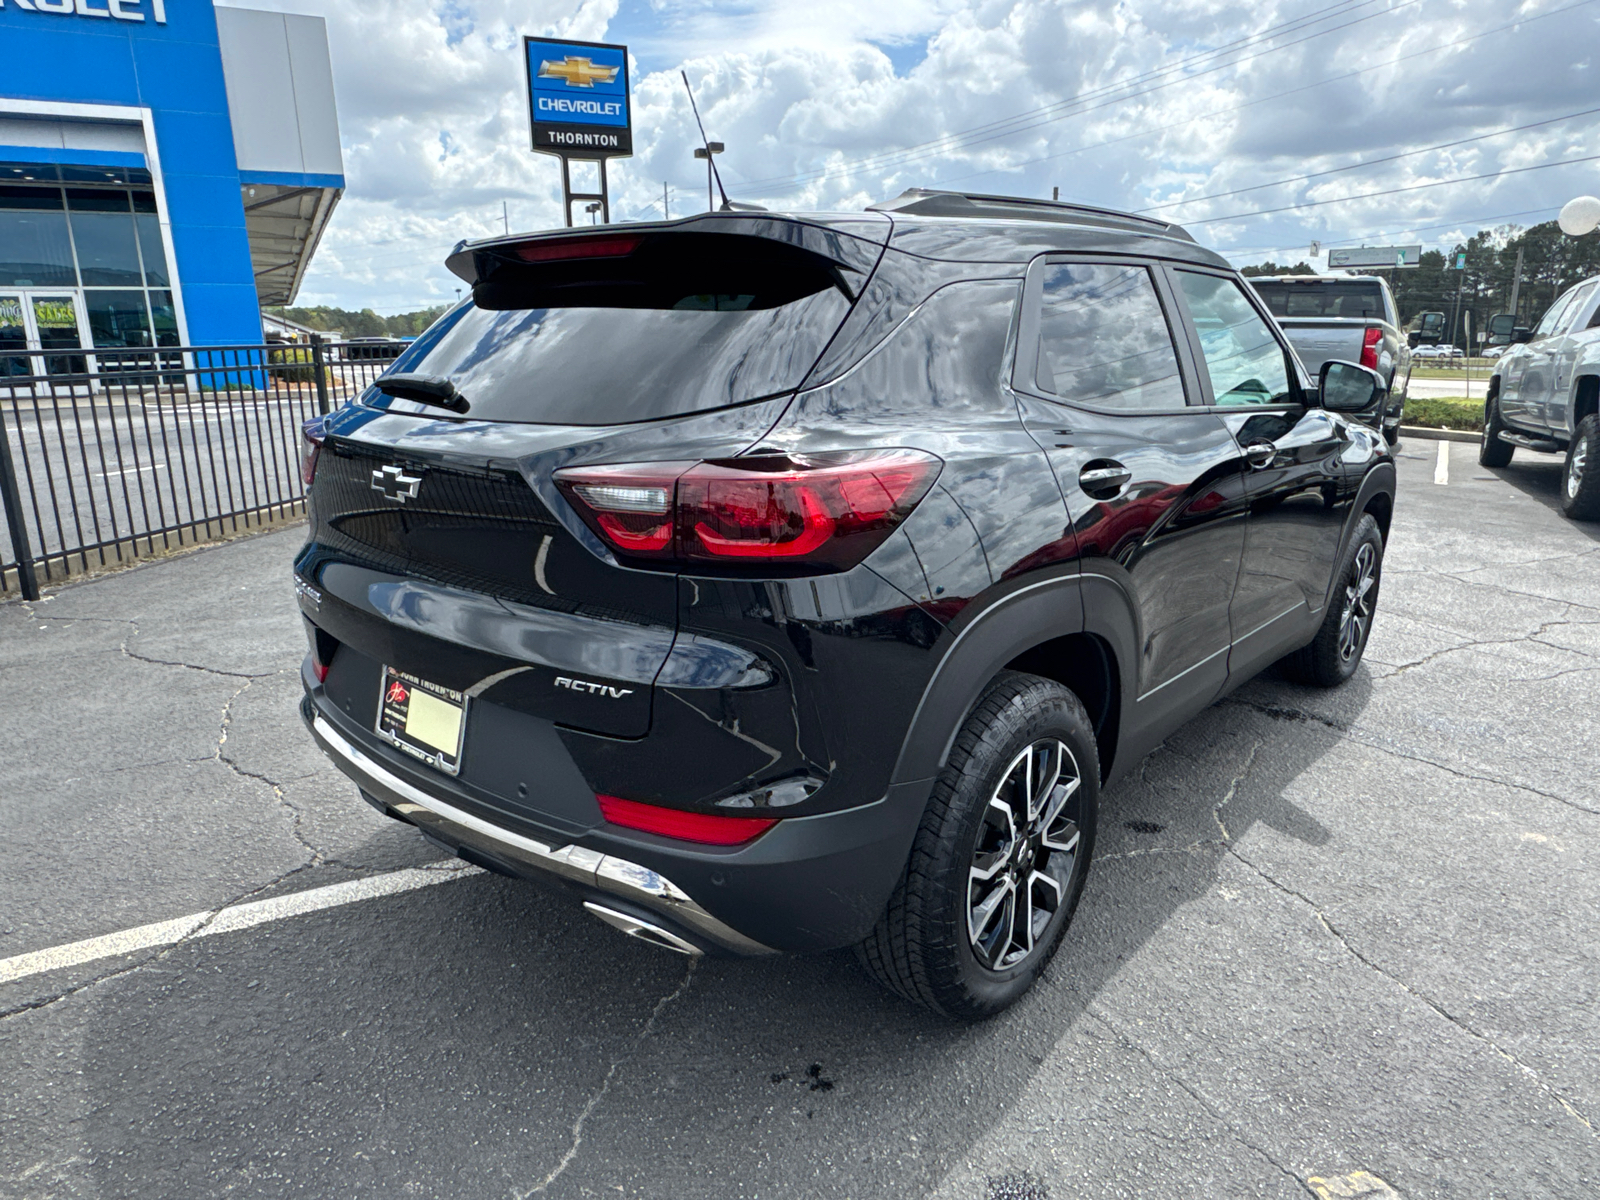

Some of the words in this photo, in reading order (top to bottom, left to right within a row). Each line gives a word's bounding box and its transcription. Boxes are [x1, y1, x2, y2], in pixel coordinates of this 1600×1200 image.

[0, 0, 167, 23] LET
[538, 97, 622, 116] CHEVROLET
[548, 131, 618, 146] THORNTON
[553, 676, 634, 699] ACTIV
